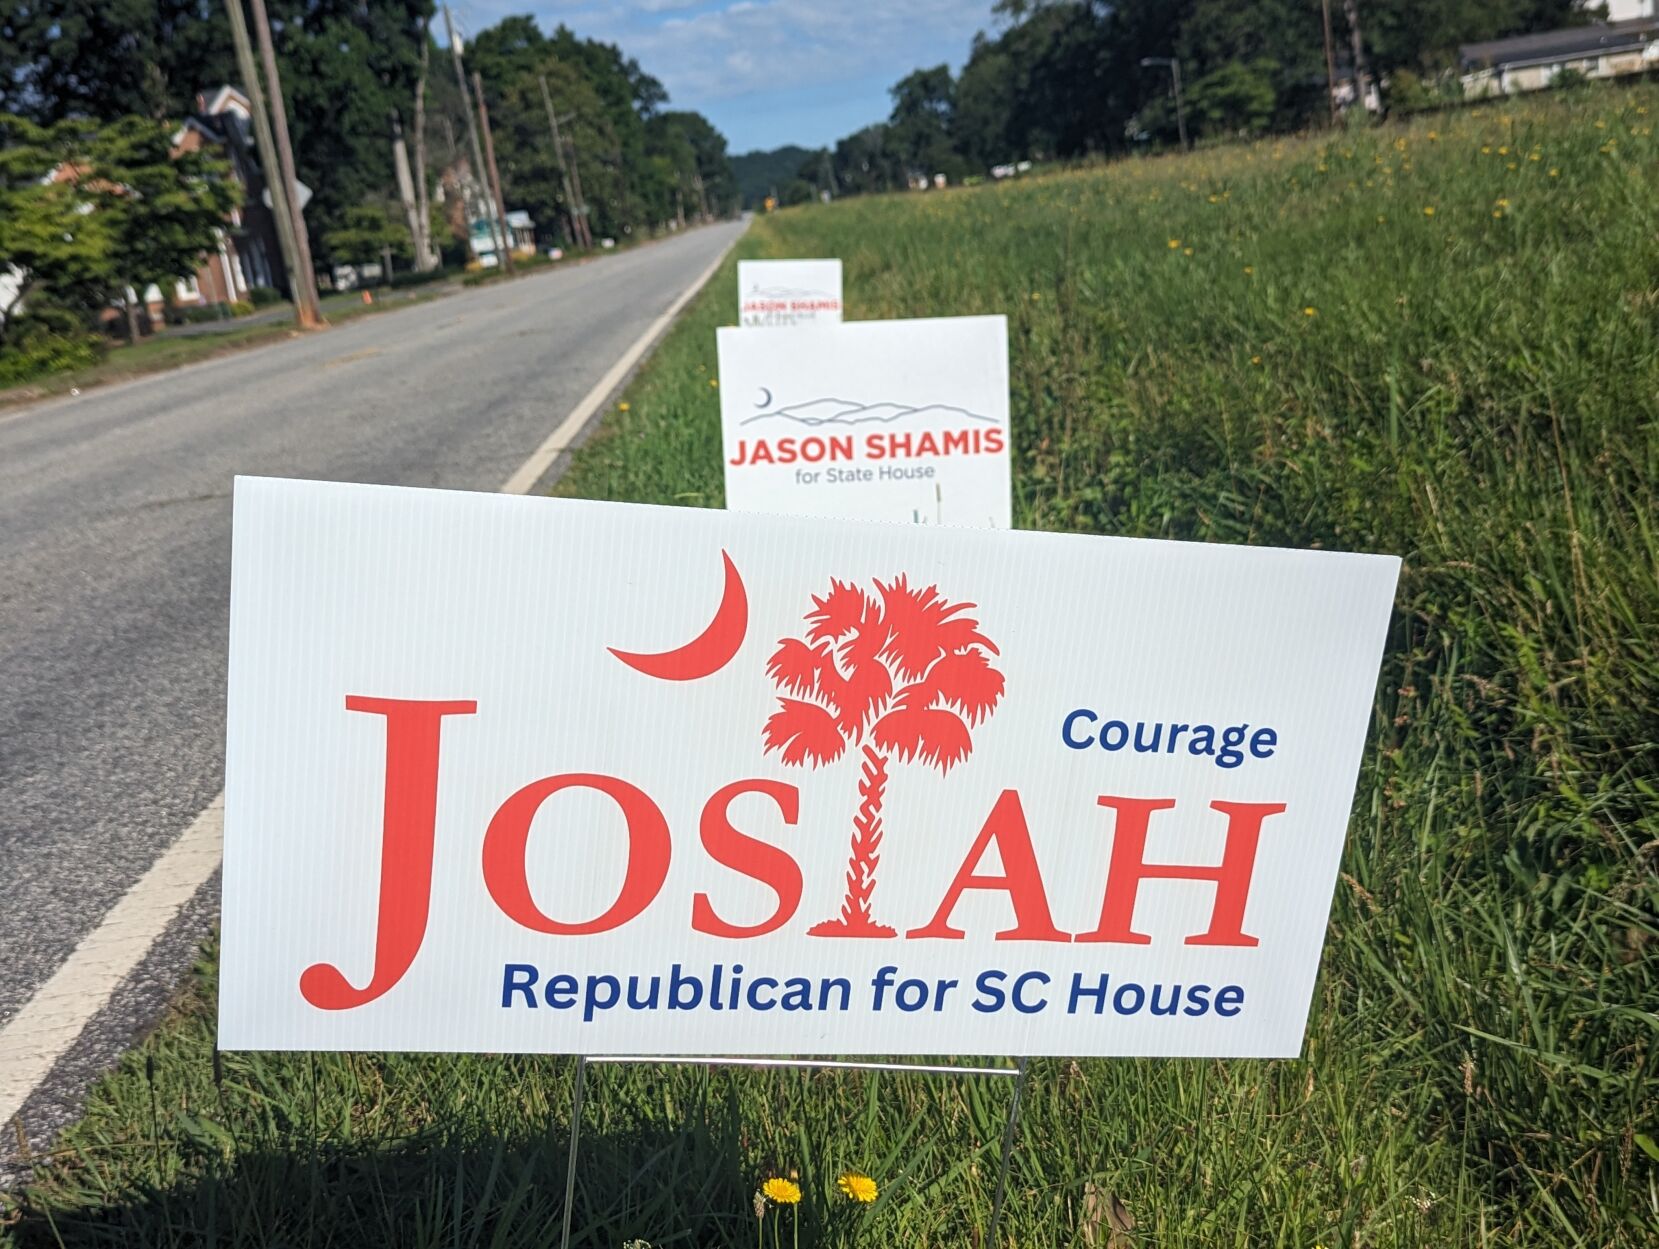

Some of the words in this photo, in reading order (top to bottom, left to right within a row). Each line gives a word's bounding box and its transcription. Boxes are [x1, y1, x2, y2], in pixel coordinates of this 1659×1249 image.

[730, 436, 854, 466] JASON
[865, 428, 1004, 460] SHAMIS
[795, 468, 820, 484] for
[826, 467, 874, 483] State
[879, 465, 935, 480] House
[1062, 708, 1278, 769] Courage
[501, 963, 852, 1023] Republican
[871, 965, 959, 1012] for
[972, 970, 1051, 1014] SC
[1067, 972, 1245, 1018] House
